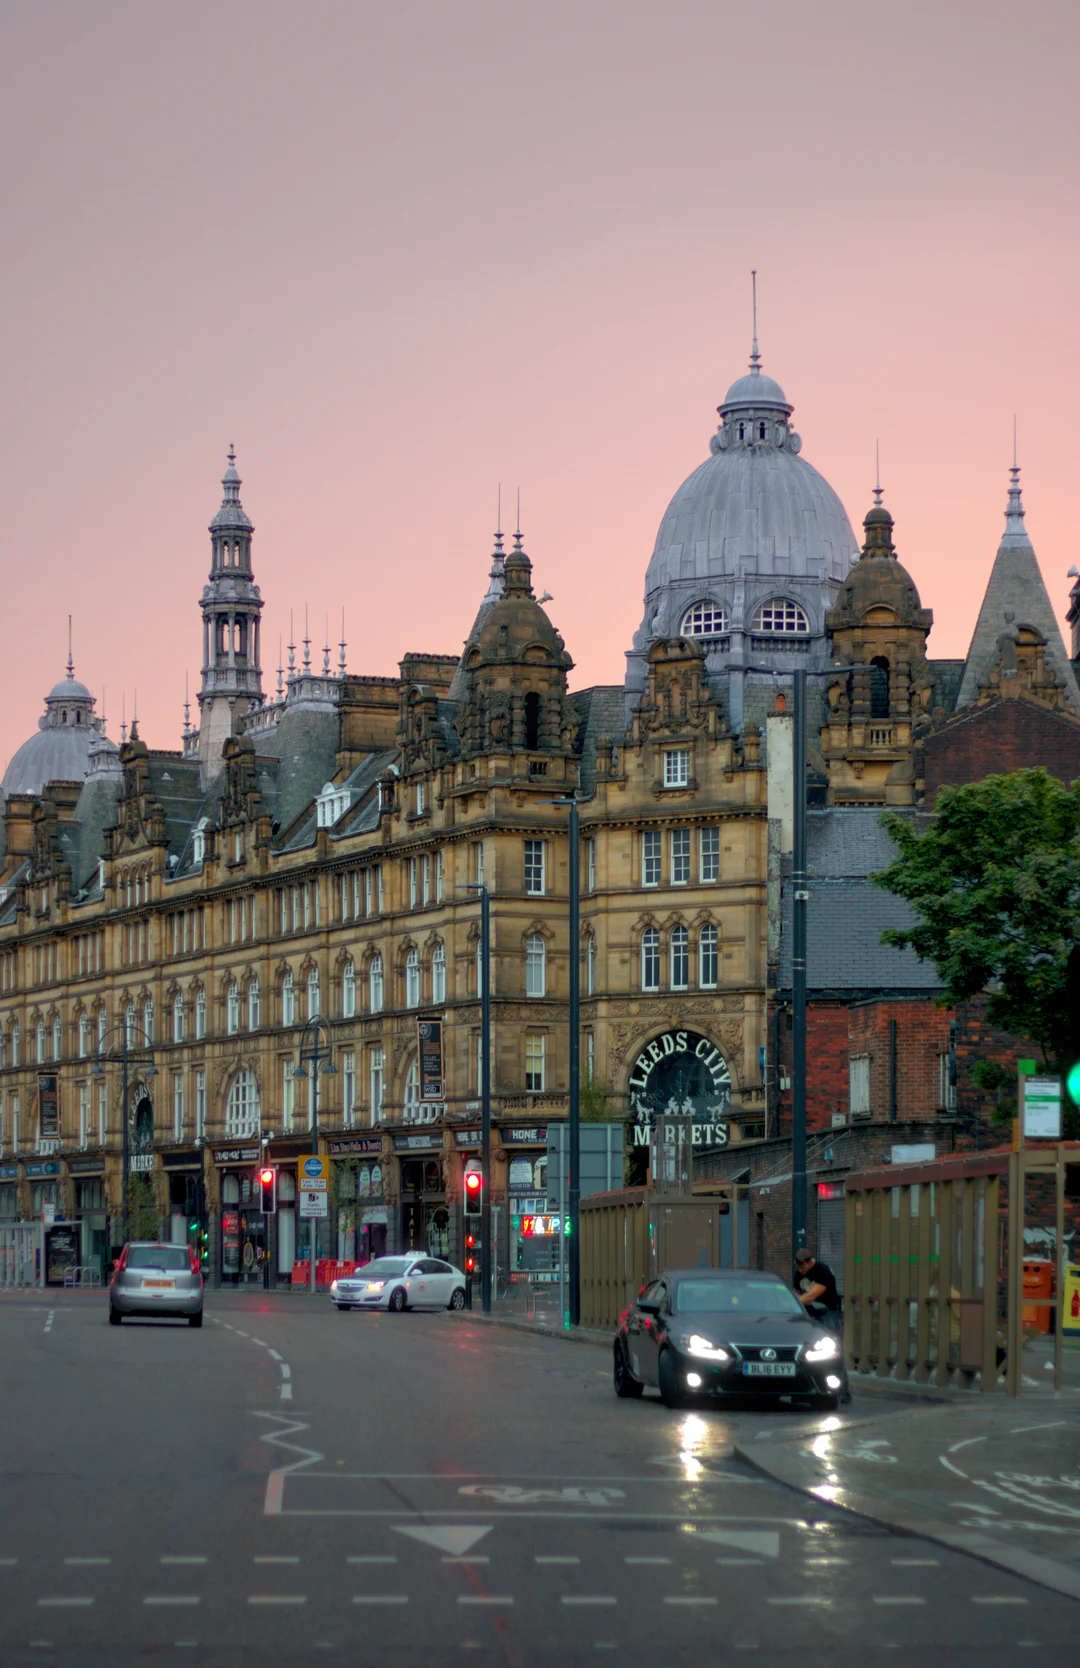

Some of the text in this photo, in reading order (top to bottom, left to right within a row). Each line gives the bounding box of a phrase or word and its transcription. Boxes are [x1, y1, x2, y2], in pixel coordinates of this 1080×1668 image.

[629, 1031, 732, 1088] LEEDS CITY
[633, 1123, 727, 1146] MRKETS
[751, 1364, 792, 1374] BL16 EYY
